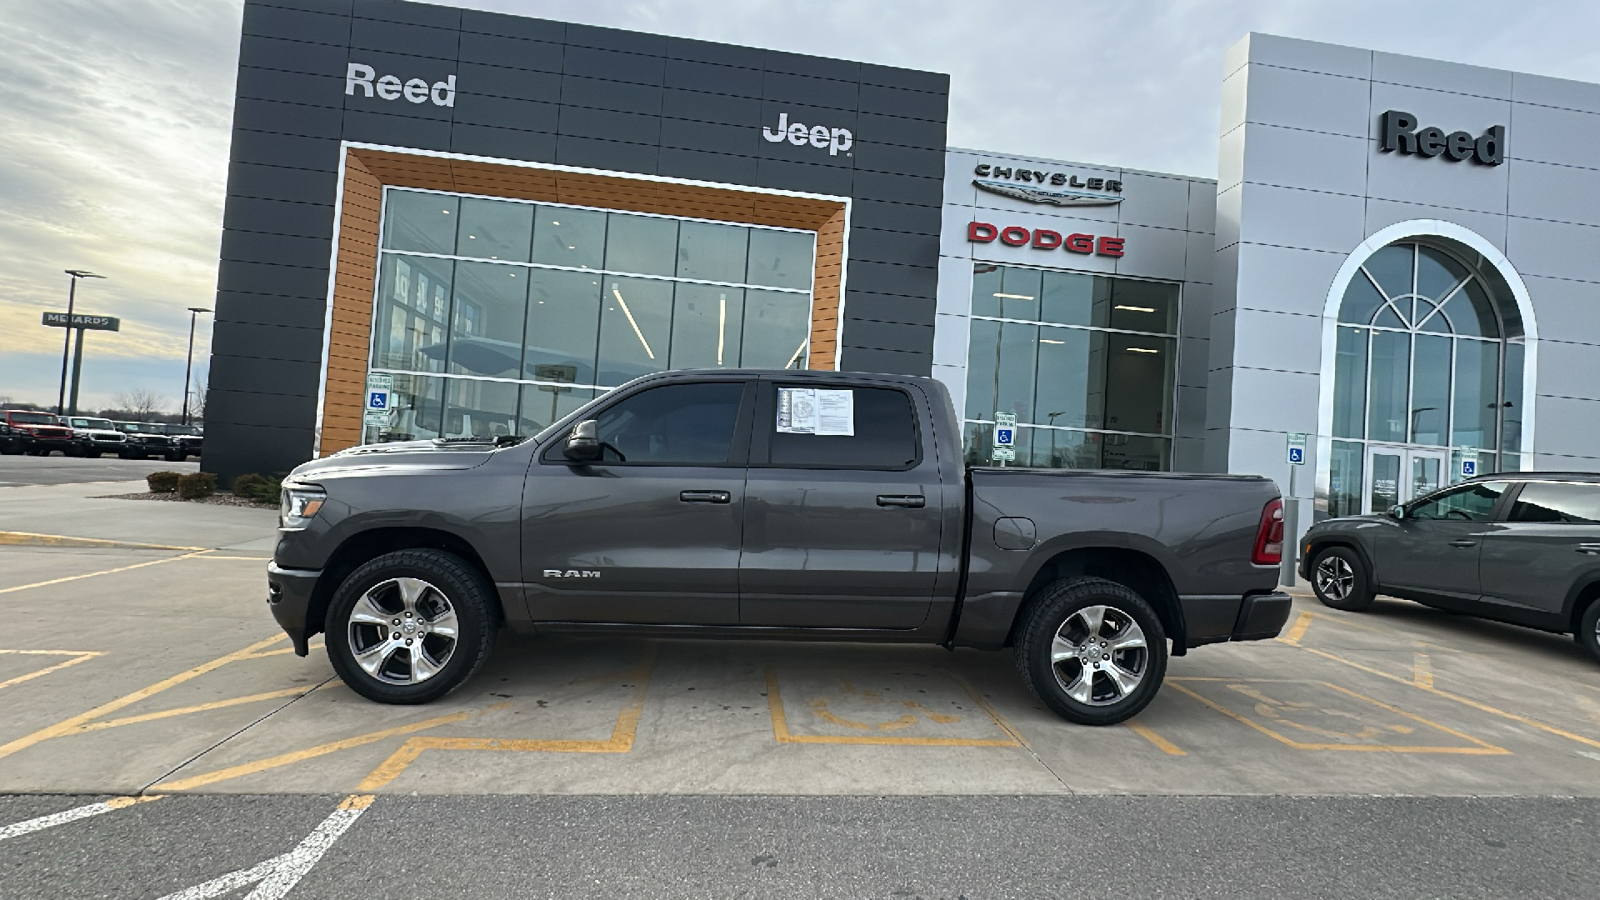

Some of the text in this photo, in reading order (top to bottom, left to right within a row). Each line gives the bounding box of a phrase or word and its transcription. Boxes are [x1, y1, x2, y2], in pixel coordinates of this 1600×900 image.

[345, 62, 457, 108] Reed
[762, 112, 853, 156] Jeep
[1381, 109, 1505, 166] Reed
[974, 163, 1123, 192] CHRYSLER
[968, 221, 1126, 258] DODGE
[543, 569, 601, 578] RAM
